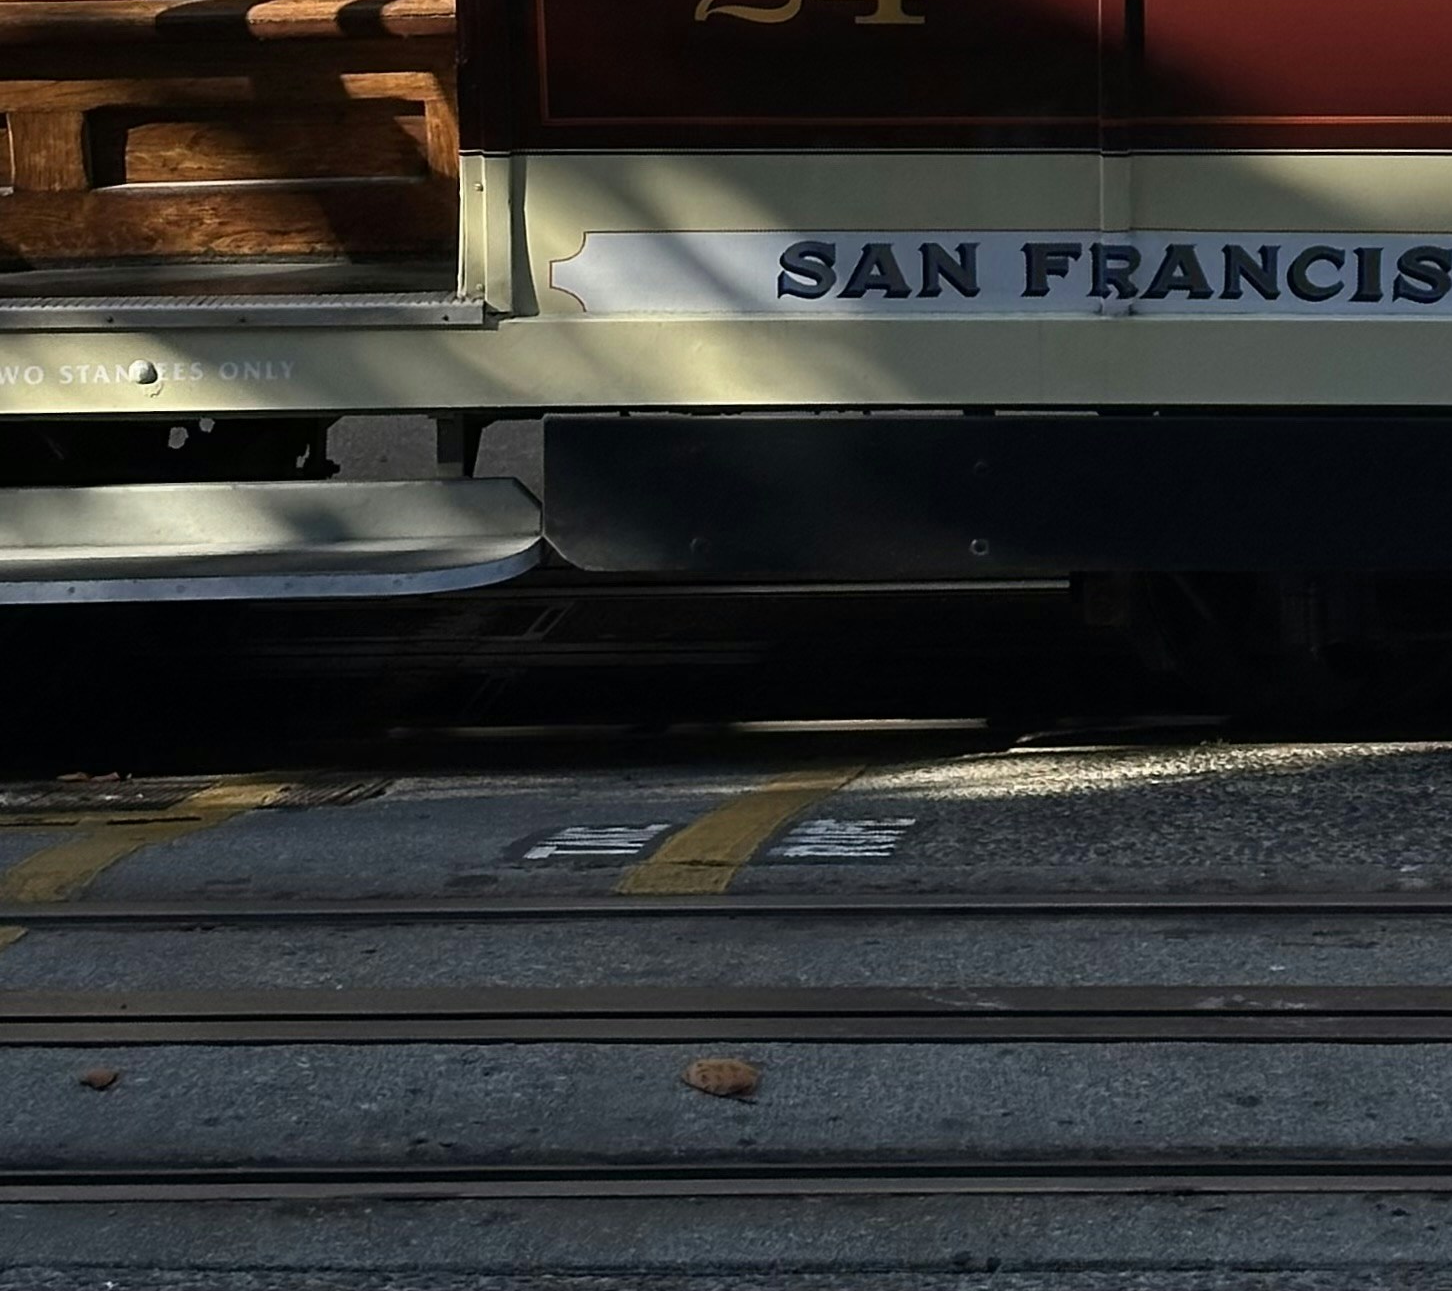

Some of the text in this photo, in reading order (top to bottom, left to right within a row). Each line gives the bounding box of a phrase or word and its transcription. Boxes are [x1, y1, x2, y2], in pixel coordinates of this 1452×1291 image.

[777, 239, 982, 300] SAN
[59, 362, 203, 385] STANEES
[220, 361, 296, 381] ONLY
